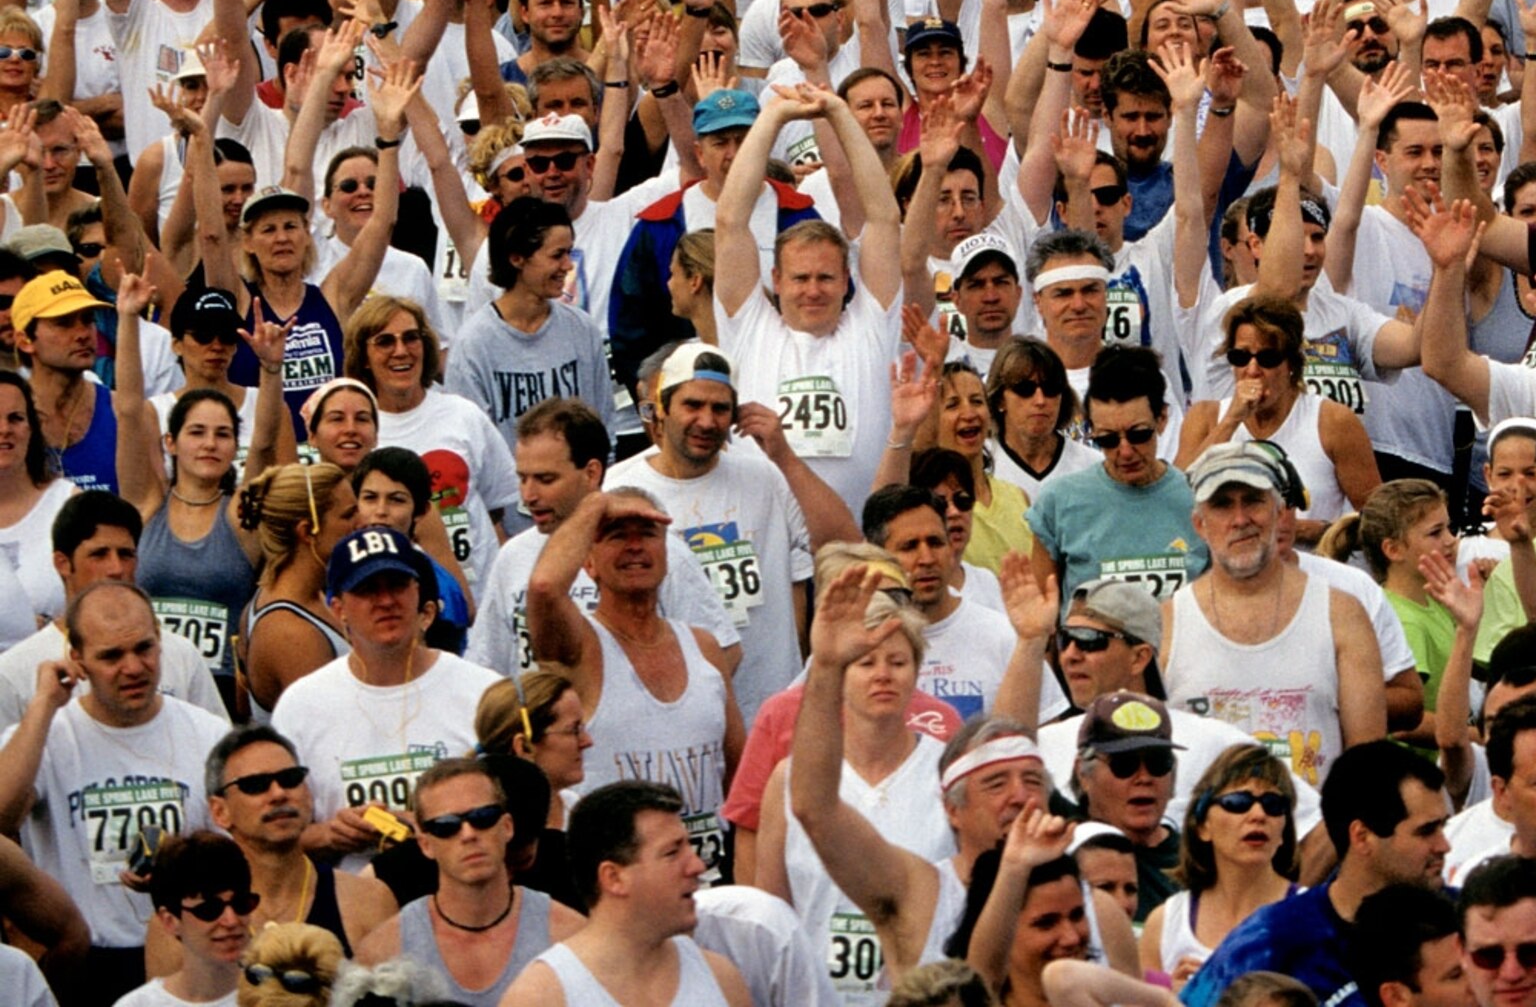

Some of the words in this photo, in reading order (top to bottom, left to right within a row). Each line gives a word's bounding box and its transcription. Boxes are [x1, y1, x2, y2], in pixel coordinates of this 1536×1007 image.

[284, 354, 334, 381] EAM
[778, 394, 848, 431] 2450
[704, 559, 760, 601] 36
[934, 677, 983, 696] RUN
